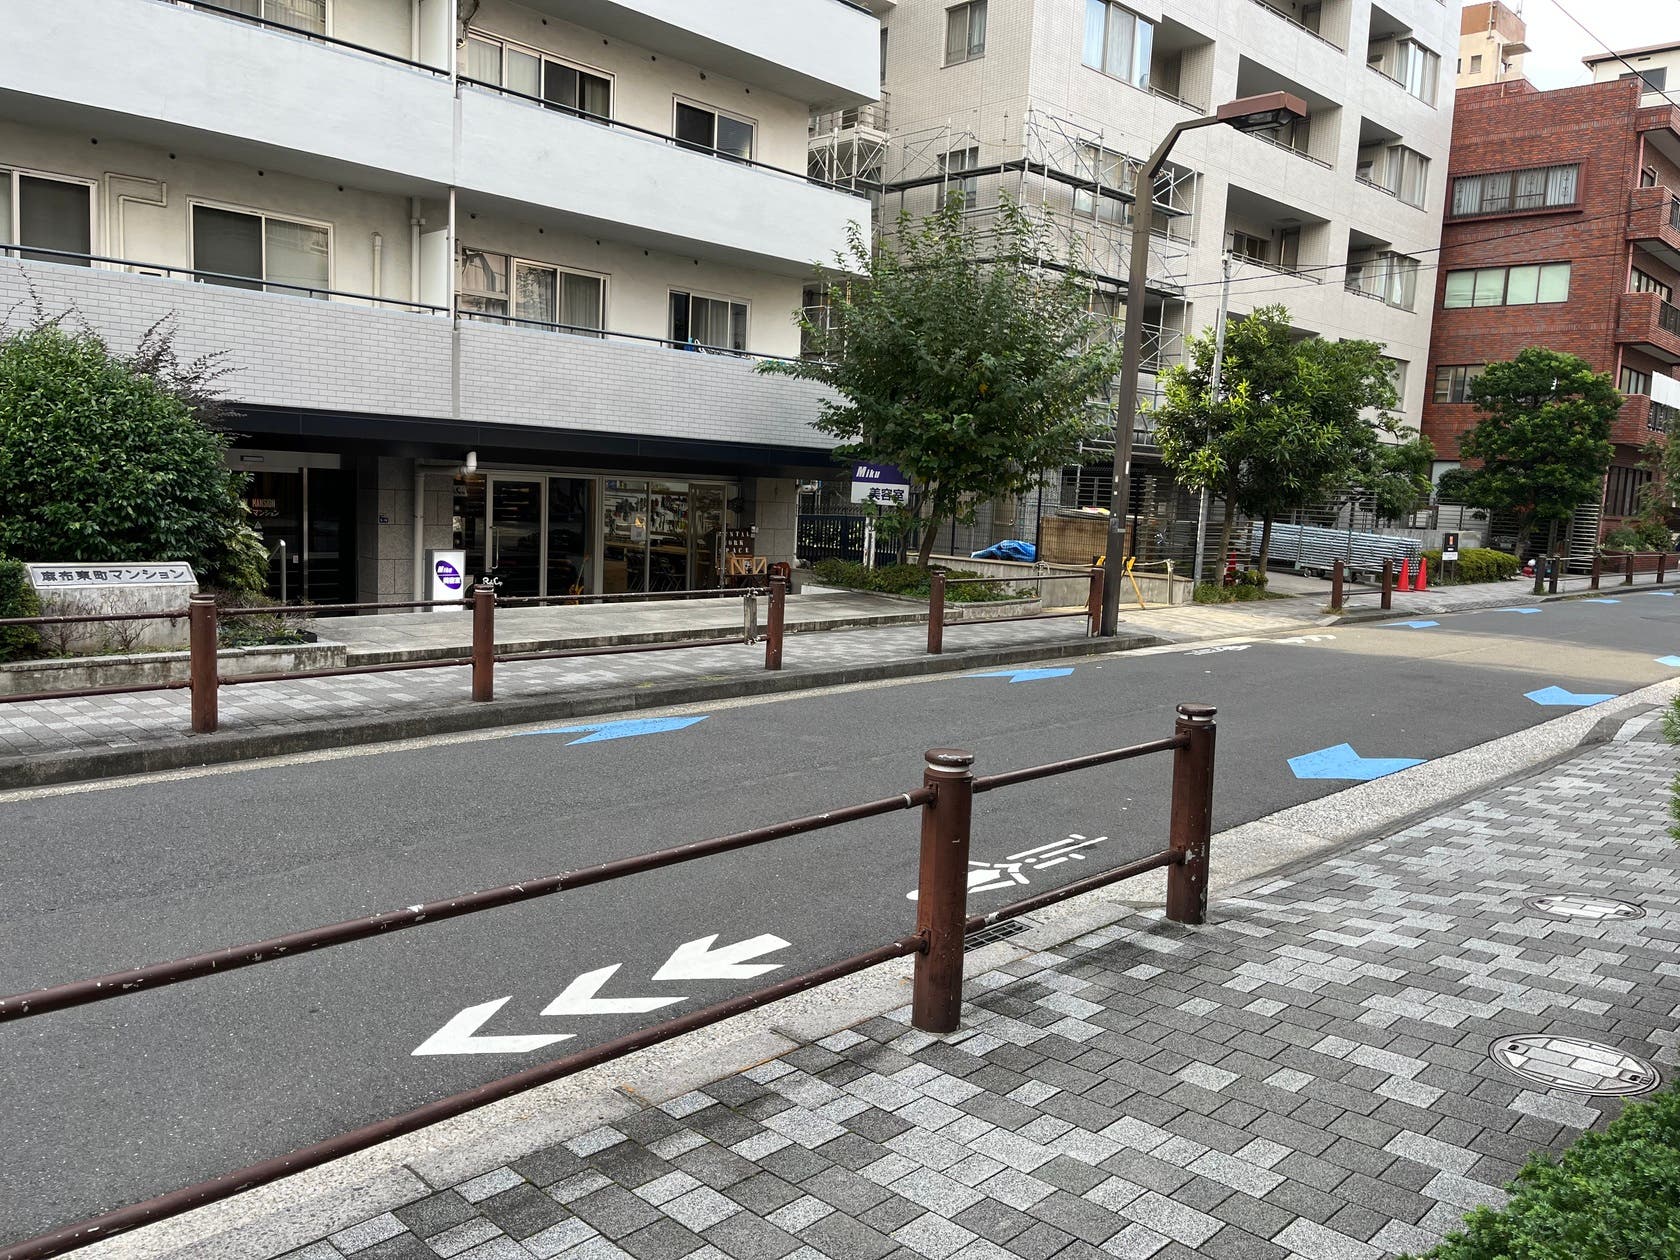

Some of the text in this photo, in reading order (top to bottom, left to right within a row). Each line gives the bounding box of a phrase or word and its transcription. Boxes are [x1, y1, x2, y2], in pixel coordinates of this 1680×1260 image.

[856, 466, 880, 478] Miku
[868, 487, 904, 501] 美容室
[40, 569, 184, 582] 麻布東町マンション
